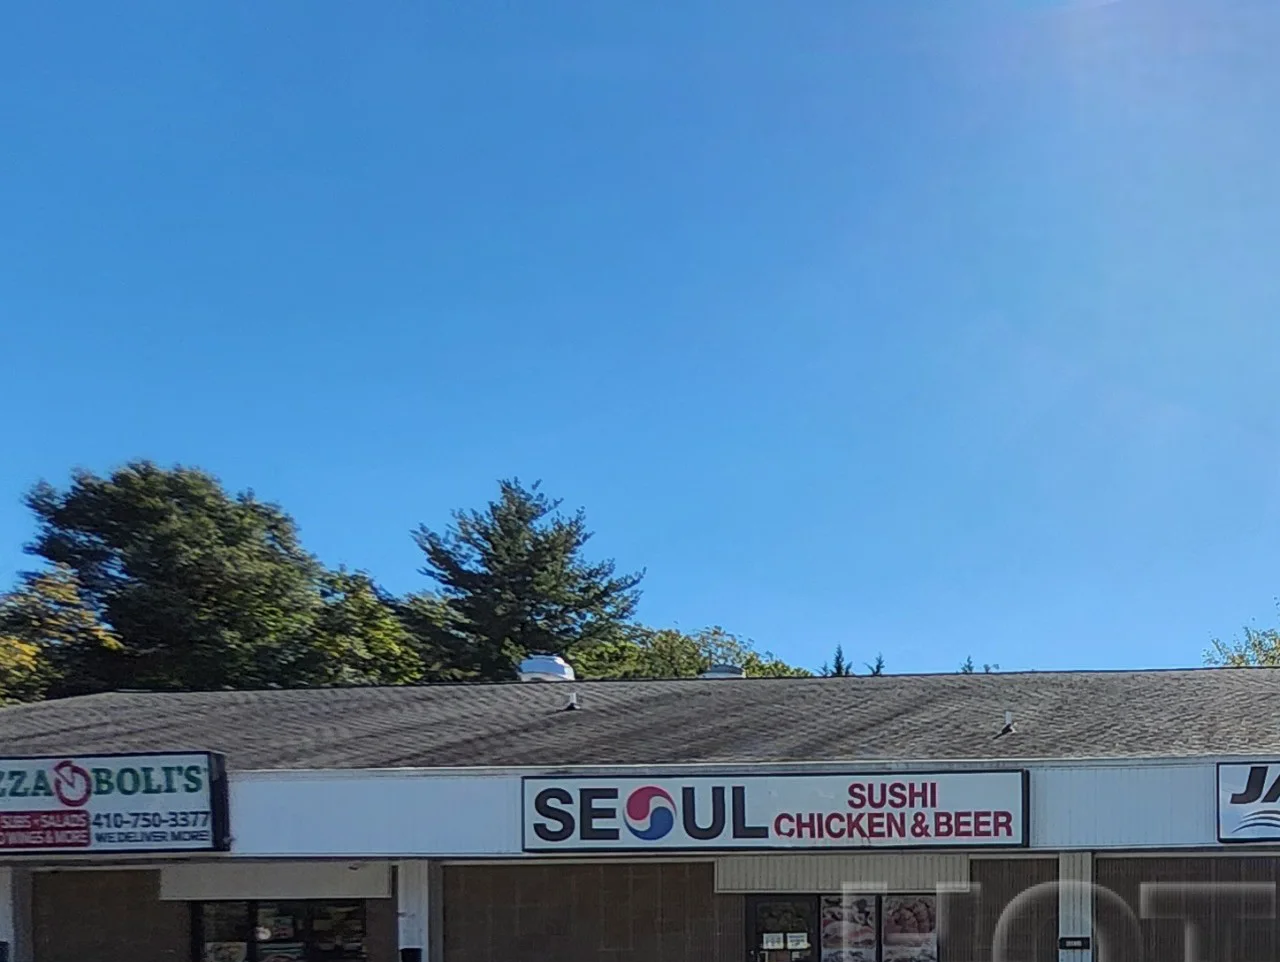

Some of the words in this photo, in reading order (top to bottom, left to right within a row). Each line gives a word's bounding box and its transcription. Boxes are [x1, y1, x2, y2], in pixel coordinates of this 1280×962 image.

[92, 765, 203, 796] BOLI'S
[848, 782, 937, 809] SUSHI
[92, 811, 210, 829] 410-750-3377
[934, 811, 1013, 838] BEER
